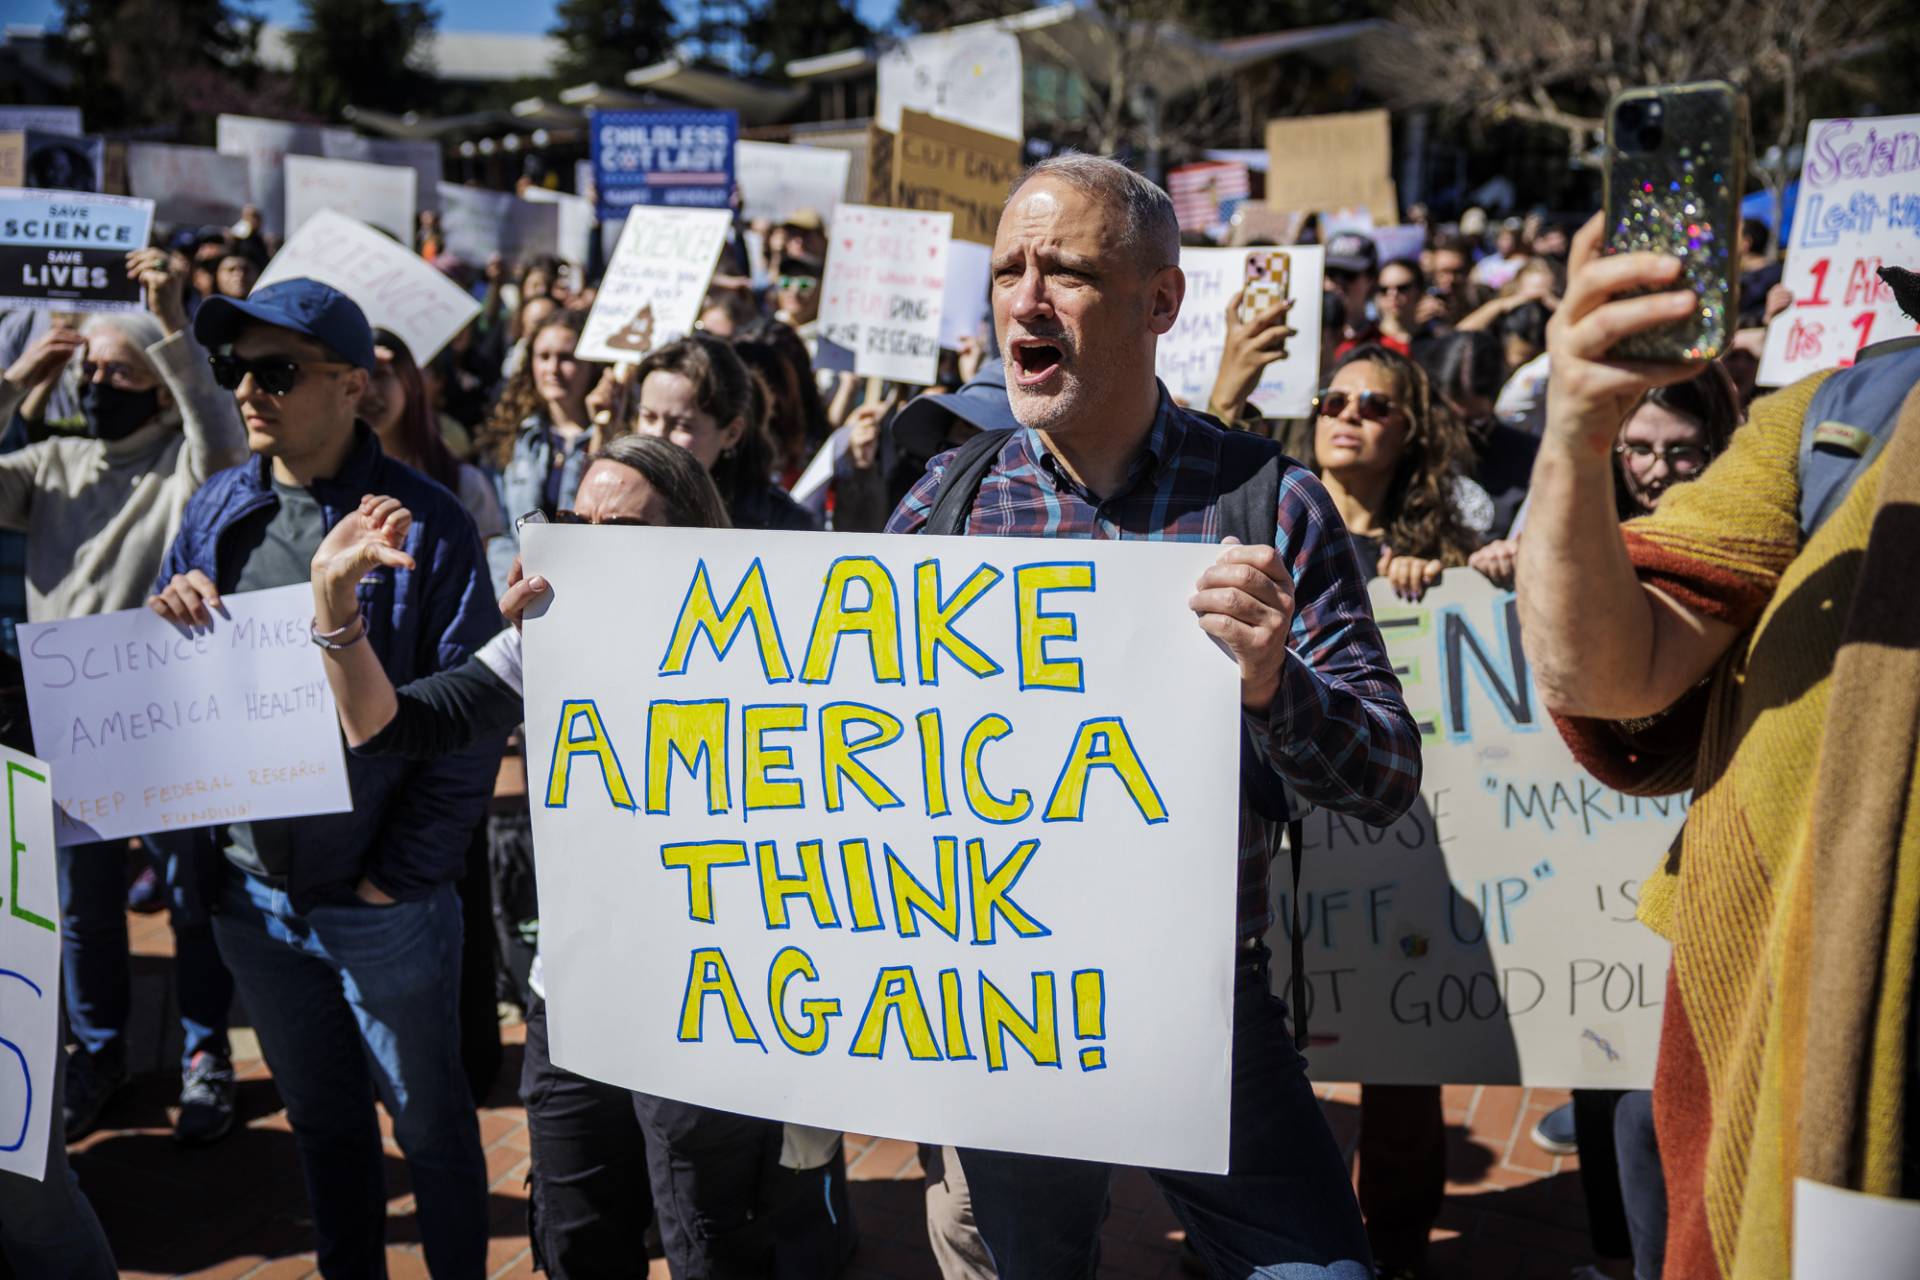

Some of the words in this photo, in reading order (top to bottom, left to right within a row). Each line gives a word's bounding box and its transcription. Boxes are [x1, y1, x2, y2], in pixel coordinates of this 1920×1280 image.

[5, 219, 132, 244] SCIENCE
[49, 204, 90, 219] SAVE
[22, 264, 109, 288] LIVES
[47, 250, 83, 265] SAVE
[30, 626, 208, 689] SCIENCE
[231, 616, 310, 650] MAKES
[659, 554, 1096, 693] MAKE
[71, 694, 221, 753] AMERICA
[245, 677, 326, 721] HEALTHY
[60, 790, 125, 831] KEEP
[143, 776, 234, 807] FEDERAL
[248, 760, 327, 785] RESEARCH
[544, 698, 1170, 824] AMERICA
[660, 836, 1053, 945] THINK
[677, 946, 1107, 1072] AGAIN!
[1390, 967, 1546, 1028] GOOD
